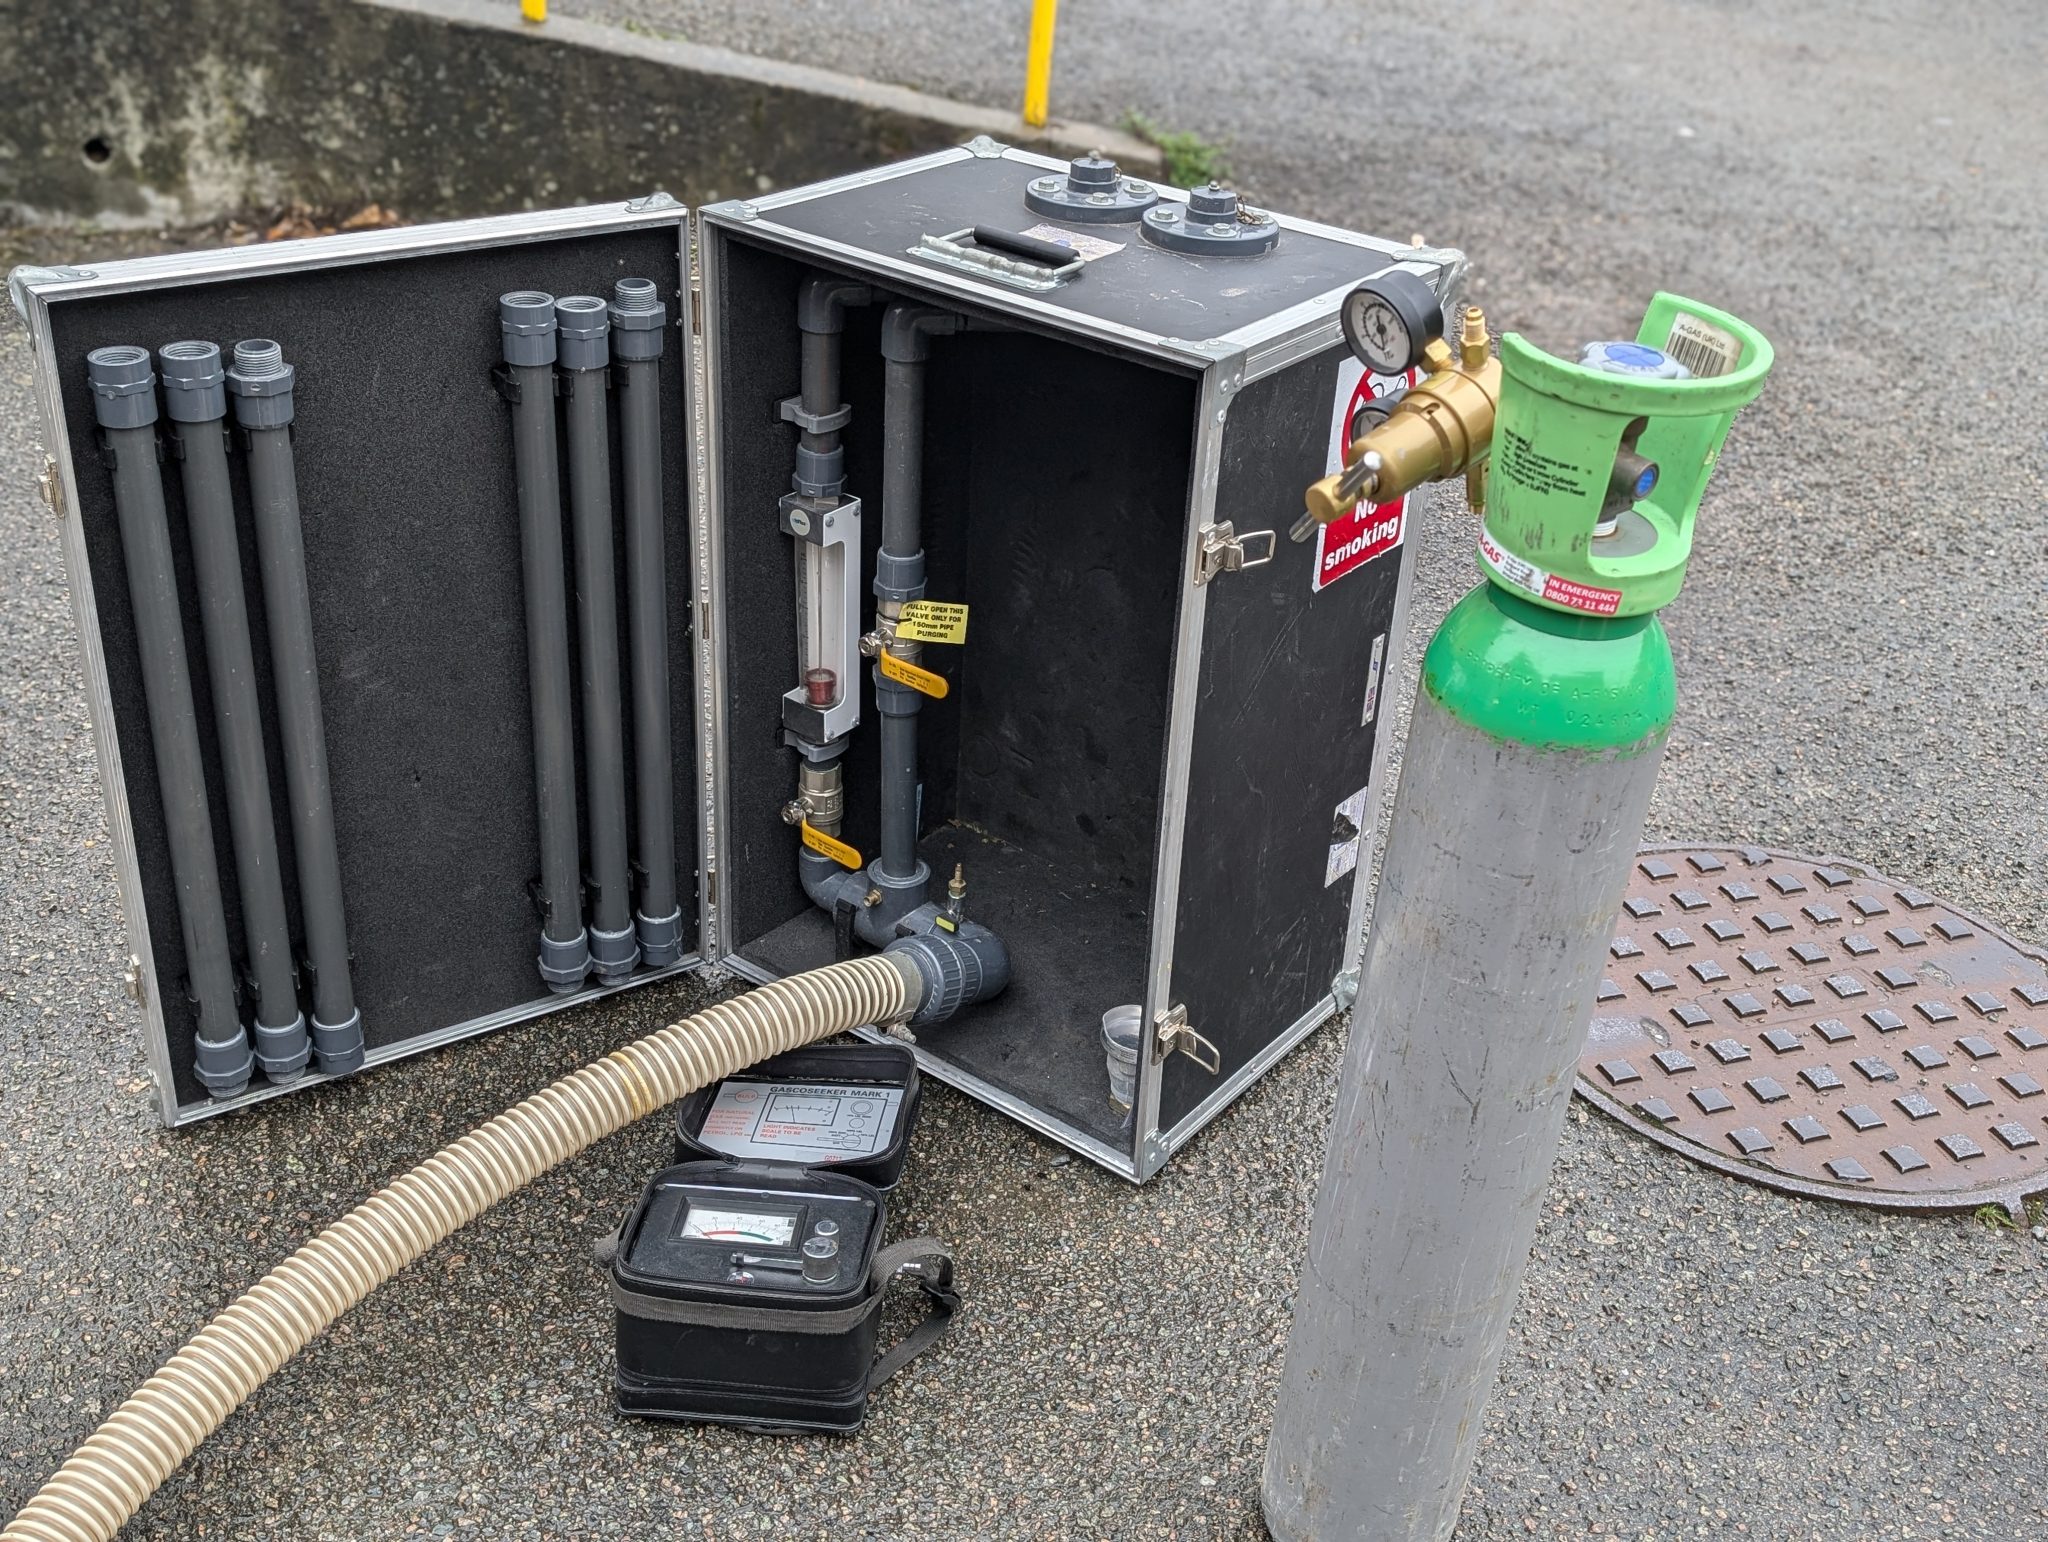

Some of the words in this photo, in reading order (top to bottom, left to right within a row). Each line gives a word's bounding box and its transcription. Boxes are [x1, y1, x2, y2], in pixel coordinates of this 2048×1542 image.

[1679, 324, 1702, 338] A-GAS
[1324, 515, 1399, 571] smoking
[1549, 578, 1560, 589] IN
[1561, 582, 1621, 602] EMERGENCY
[1545, 589, 1569, 603] 0800
[1584, 599, 1596, 610] 11
[1597, 602, 1616, 612] 444
[930, 606, 948, 614] OPEN
[916, 630, 948, 638] PURGING
[769, 1086, 847, 1096] GASCOSEEKER
[850, 1090, 882, 1098] MARK
